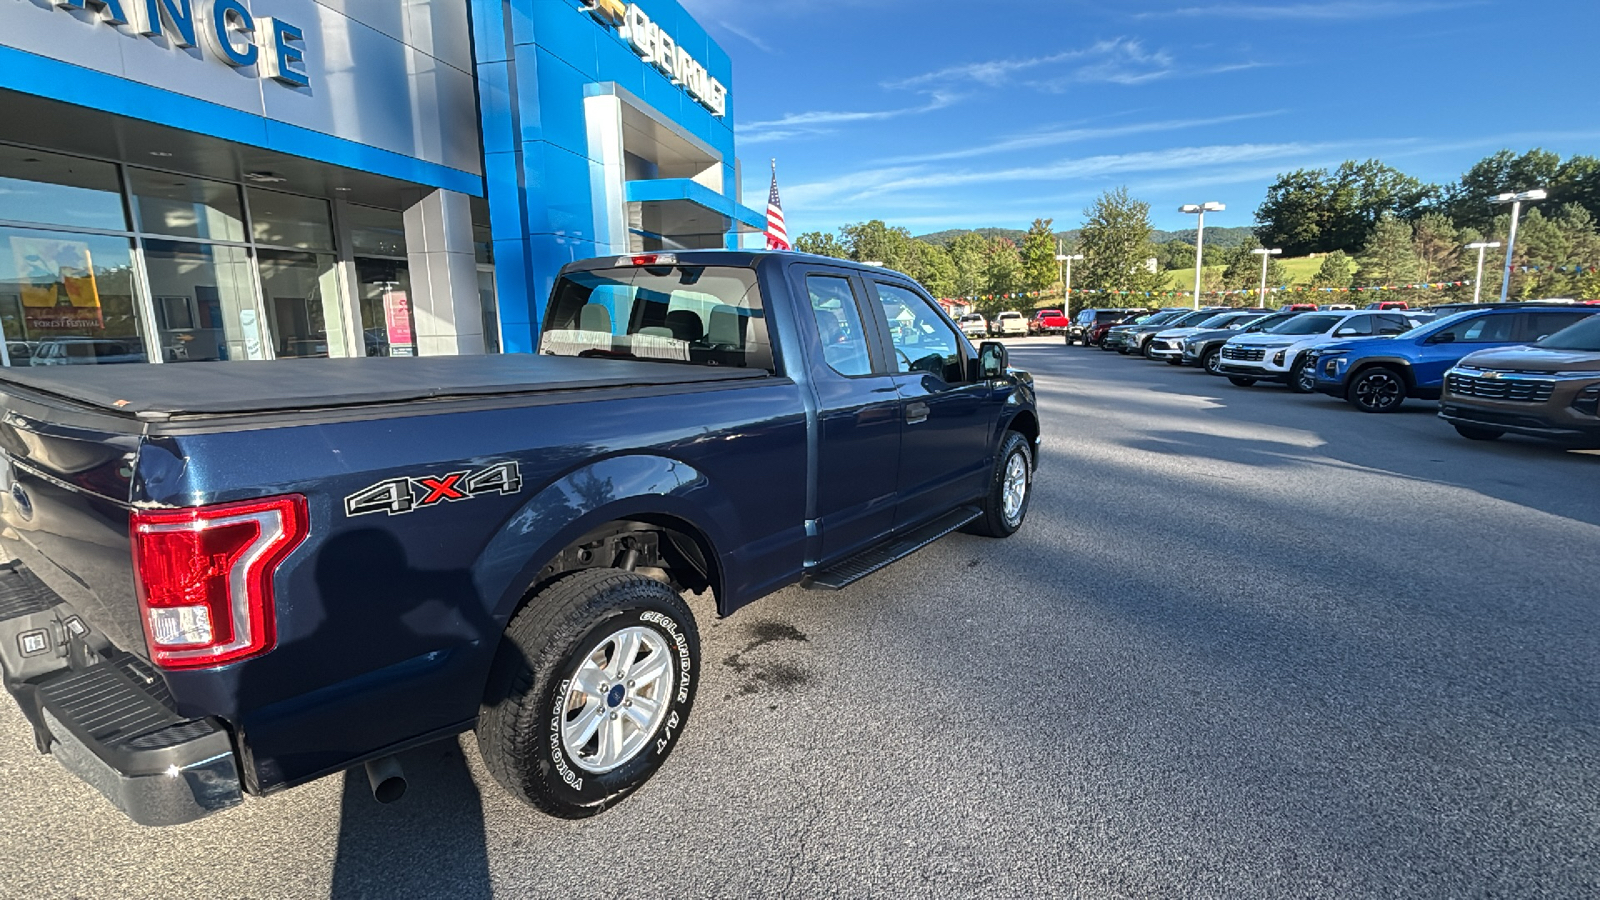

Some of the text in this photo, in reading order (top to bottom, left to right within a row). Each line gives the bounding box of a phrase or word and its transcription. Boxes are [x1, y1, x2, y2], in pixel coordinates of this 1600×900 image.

[626, 2, 727, 118] CHEVROLET
[33, 320, 99, 328] FOREST FESTIVAL
[344, 461, 523, 517] 4X4
[550, 680, 583, 791] YOKOHAMA
[640, 610, 691, 754] GEOLANDAR A/T
